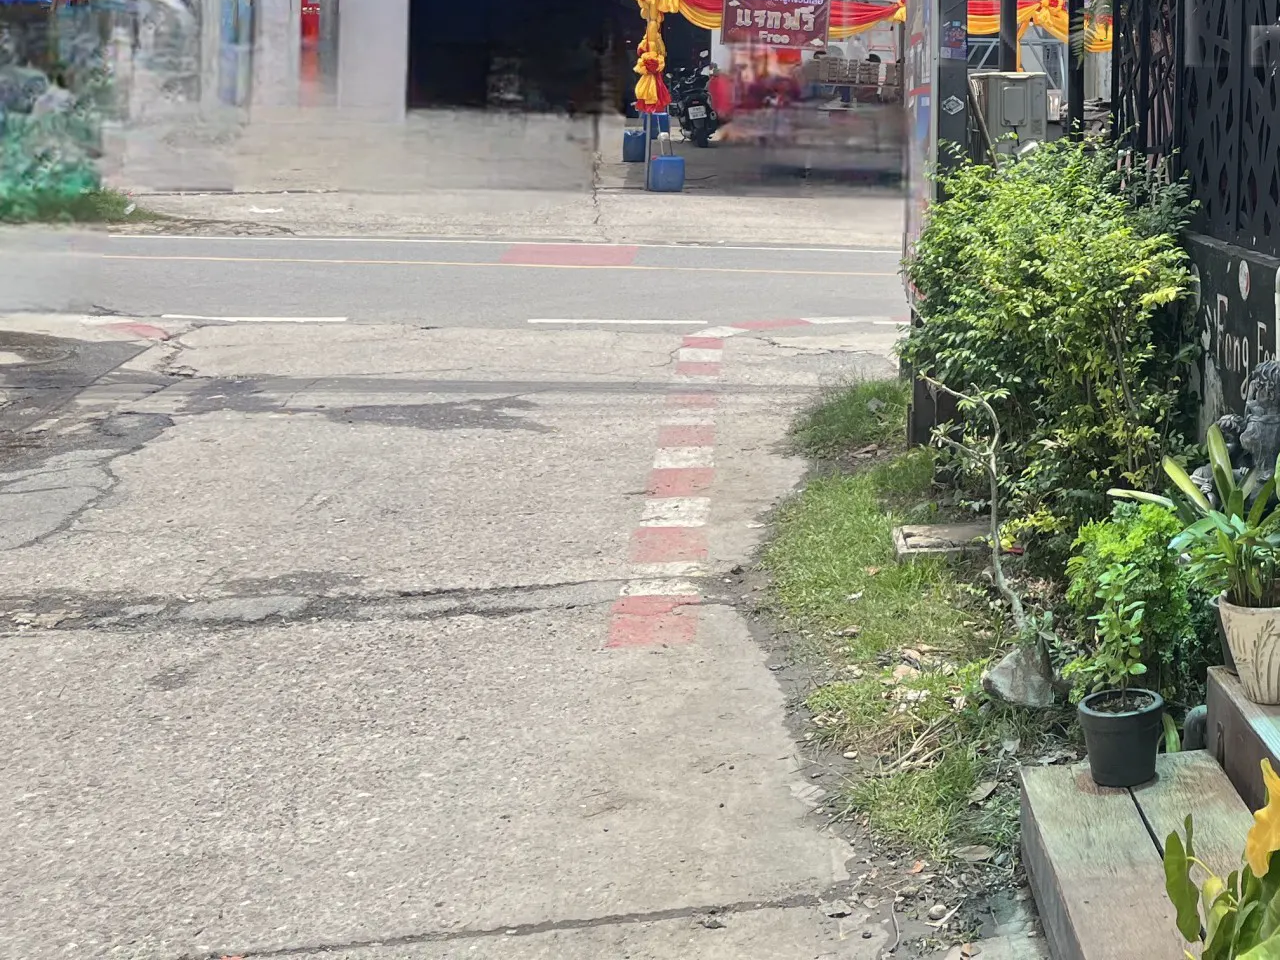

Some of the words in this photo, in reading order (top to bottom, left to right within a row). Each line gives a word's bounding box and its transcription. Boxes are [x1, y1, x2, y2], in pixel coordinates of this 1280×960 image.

[735, 6, 815, 32] แจกฟรี
[758, 30, 790, 44] Free
